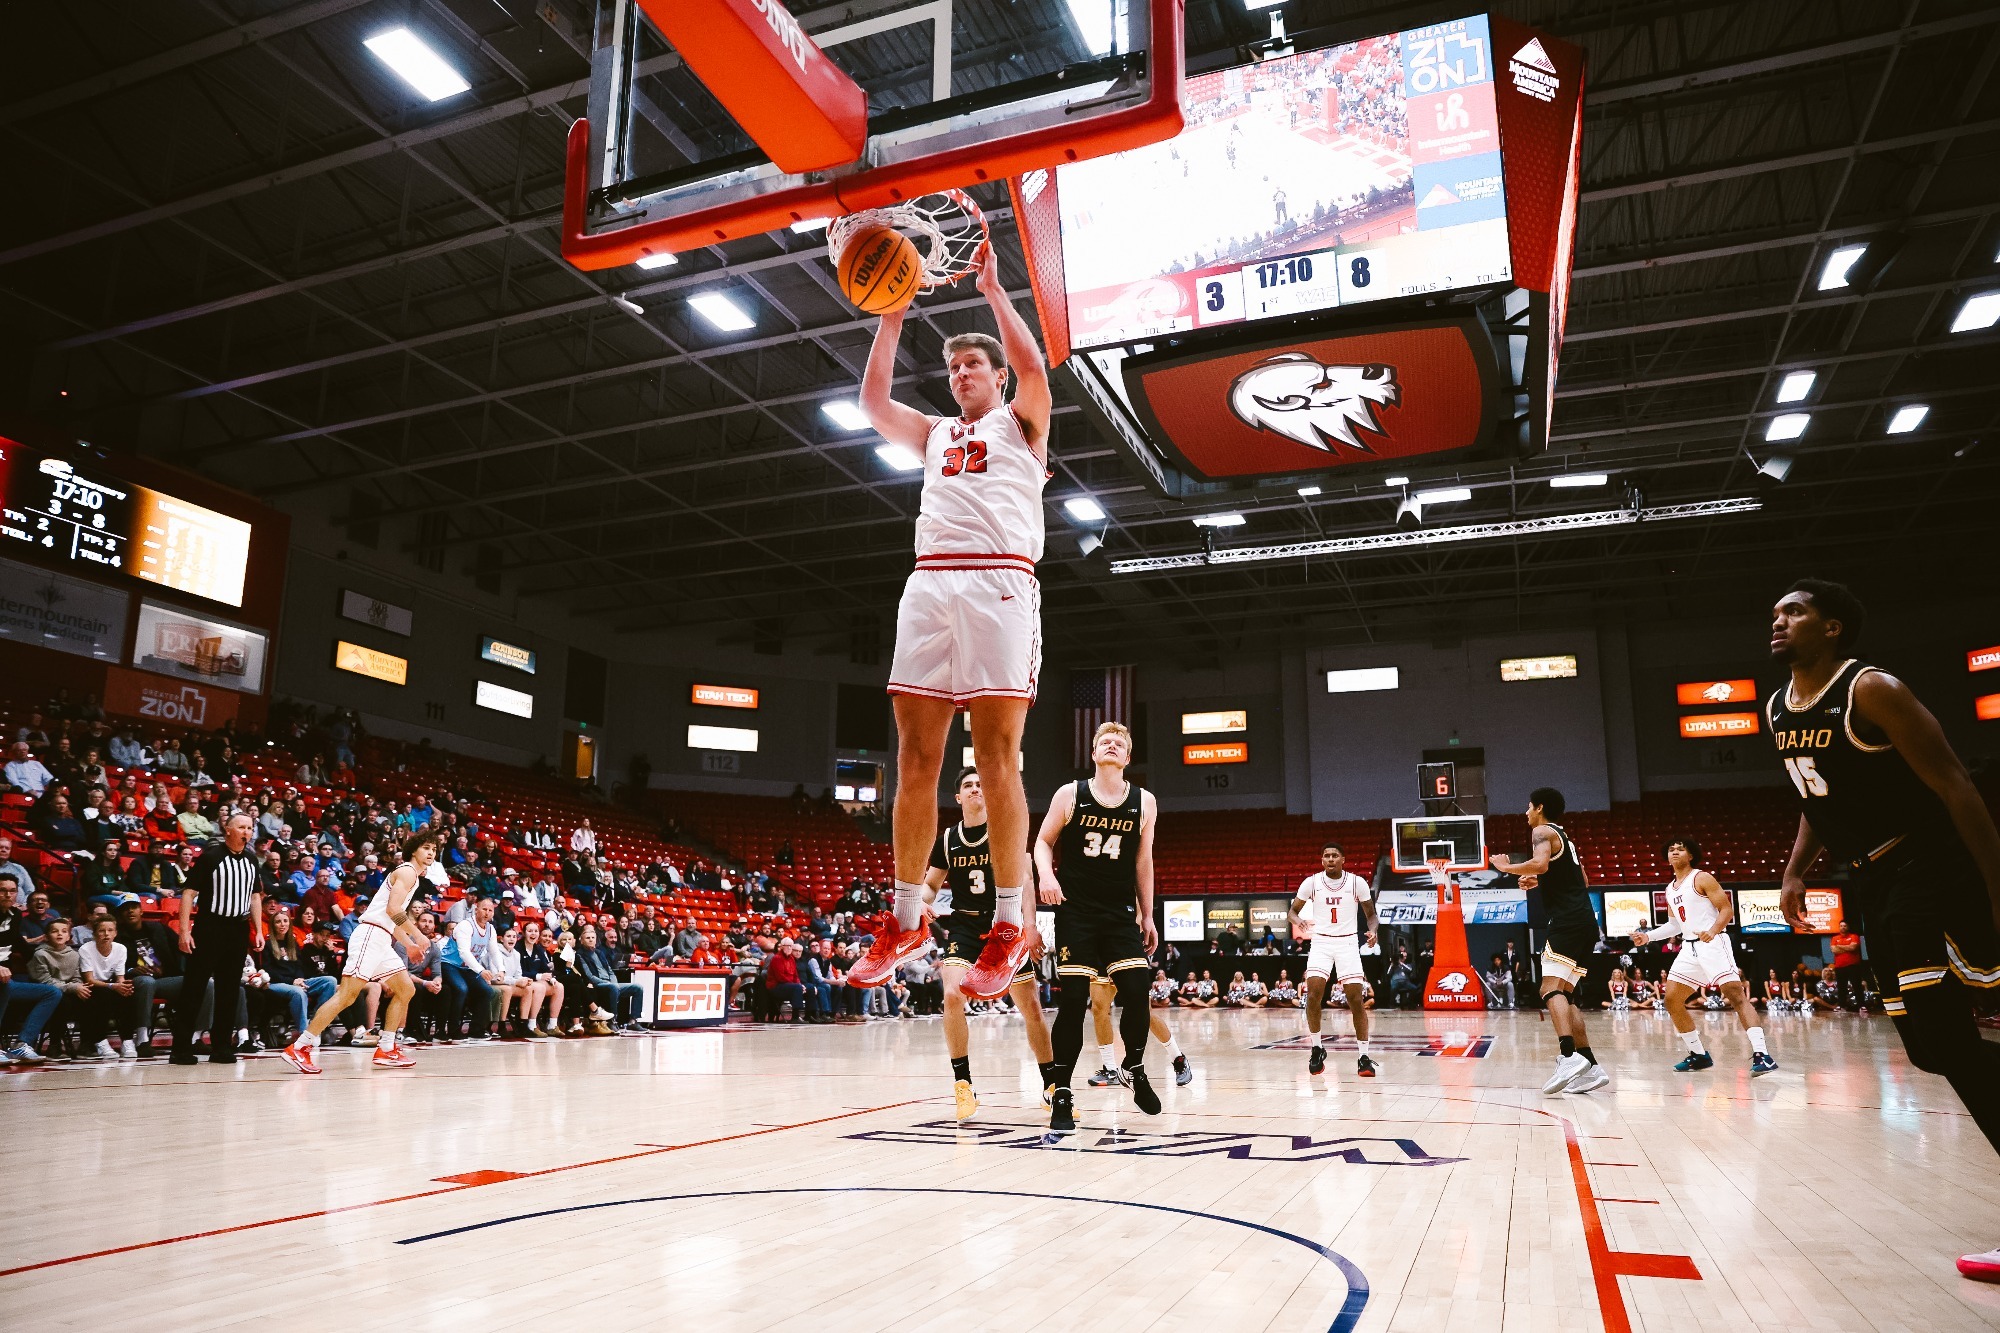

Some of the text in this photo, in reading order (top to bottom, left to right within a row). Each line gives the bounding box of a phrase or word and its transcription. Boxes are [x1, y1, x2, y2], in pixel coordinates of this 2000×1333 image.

[1407, 21, 1466, 41] GREATER
[1509, 60, 1559, 88] MOUNTAIN
[1512, 73, 1556, 98] AMERICA
[854, 237, 894, 287] Wilson
[1350, 256, 1370, 288] 8
[1500, 265, 1510, 279] 4
[1255, 257, 1312, 289] 17:10
[1205, 282, 1224, 312] 3
[942, 440, 988, 477] 32
[53, 479, 103, 510] 17:10
[37, 517, 50, 530] 2
[48, 499, 61, 515] 3
[92, 513, 106, 529] 8
[42, 535, 54, 548] 4
[105, 538, 117, 551] 2
[110, 555, 122, 568] 4
[39, 621, 96, 645] Medicine
[696, 690, 754, 703] UTAH TECH
[139, 696, 194, 723] ZION
[425, 701, 445, 721] 111
[1685, 719, 1751, 731] UTAH TECH
[708, 755, 734, 770] 112
[1188, 748, 1241, 759] UTAH TECH
[1205, 774, 1229, 788] 113
[1436, 776, 1449, 796] 6
[1784, 756, 1829, 799] 15
[1079, 814, 1135, 832] IDAHO
[1083, 831, 1123, 860] 34
[953, 853, 990, 868] IDAH
[968, 869, 987, 895] 3
[1325, 896, 1343, 906] UT
[1169, 917, 1200, 928] Star
[1330, 907, 1338, 924] 1
[1394, 905, 1424, 921] FAN
[660, 983, 723, 1012] ESPN
[1428, 994, 1478, 1003] UTAH TECH
